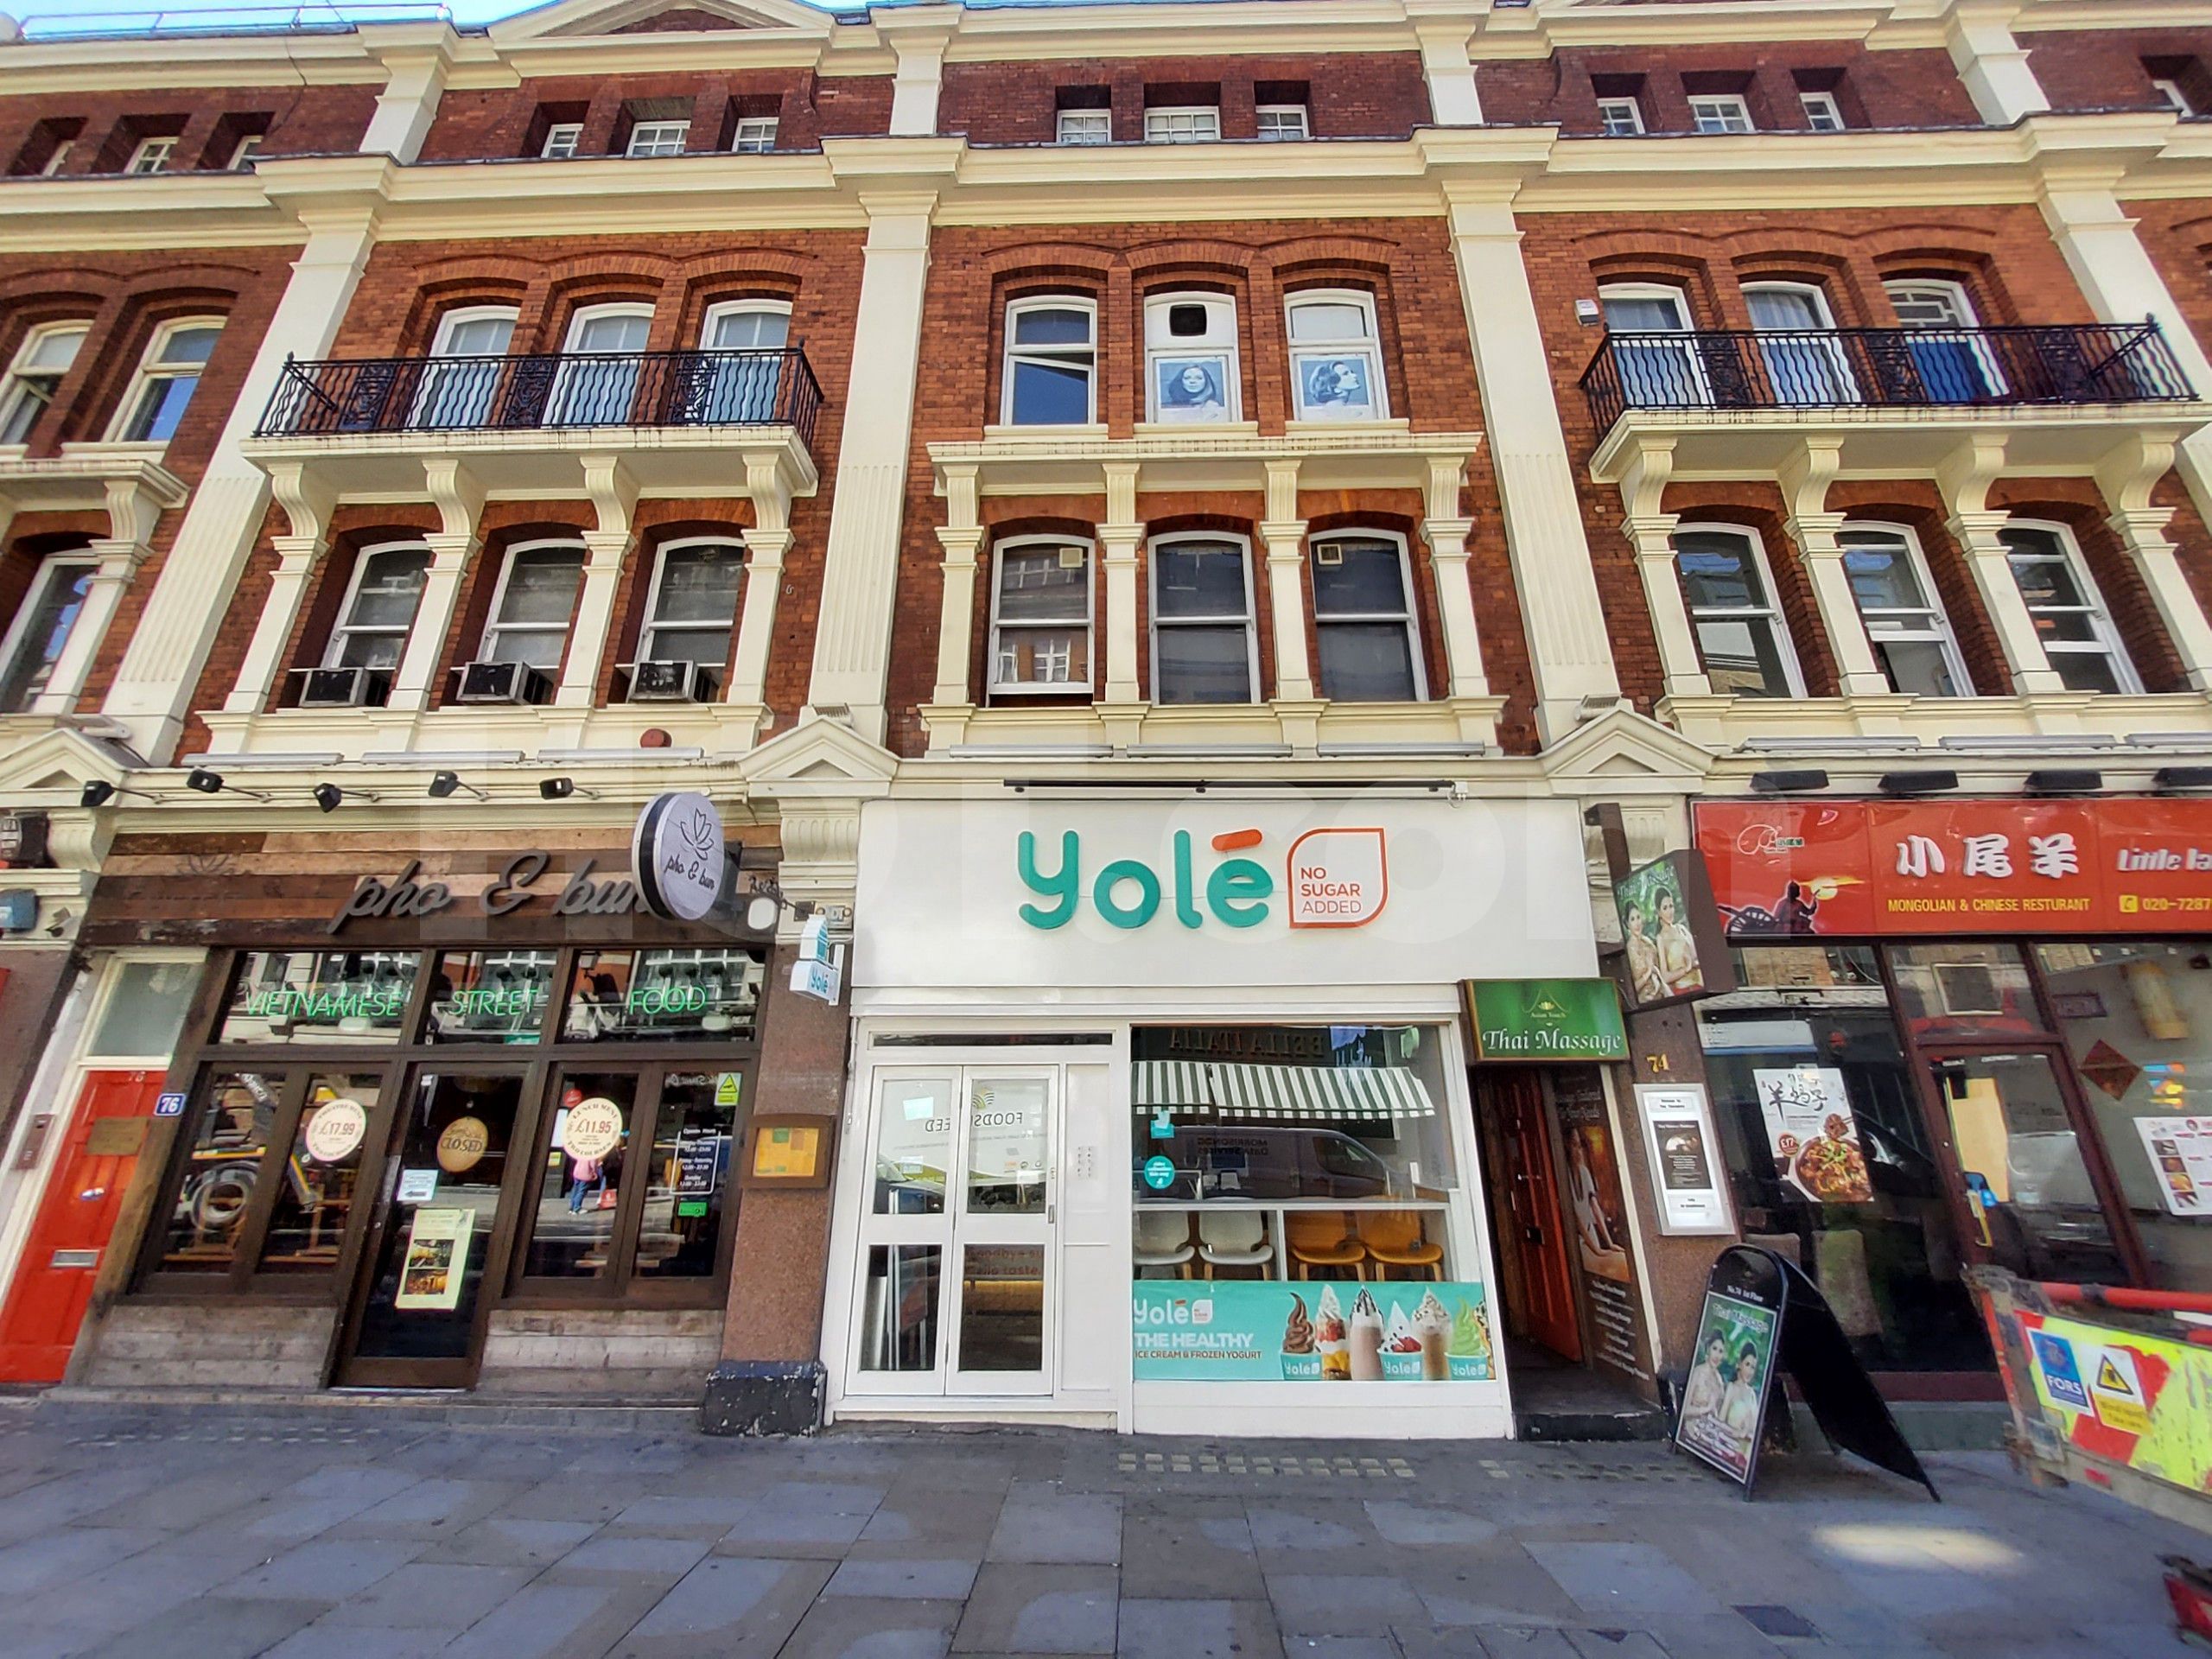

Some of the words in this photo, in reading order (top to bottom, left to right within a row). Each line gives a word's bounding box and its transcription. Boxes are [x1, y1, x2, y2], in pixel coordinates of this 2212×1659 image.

[664, 853, 684, 874] pho
[2116, 848, 2182, 872] Little
[1300, 867, 1327, 880] NO
[327, 859, 453, 935] pho
[478, 849, 553, 916] &
[553, 857, 650, 915] bu
[1300, 882, 1361, 898] SUGAR
[1301, 900, 1362, 914] ADDED
[1887, 899, 1956, 912] MONGOLIAN
[1959, 899, 1969, 912] &
[1972, 898, 2019, 912] CHINESE
[2022, 898, 2091, 912] RESTURANT
[245, 988, 404, 1018] VIETNAMESE
[451, 988, 538, 1016] STREET
[628, 986, 707, 1015] FOOD
[1481, 1028, 1530, 1050] Thai
[1535, 1027, 1622, 1056] Massage
[1646, 1053, 1670, 1073] 74
[160, 1096, 179, 1113] 76
[575, 1118, 613, 1134] £11.95
[441, 1137, 483, 1153] CLOSED
[1134, 1332, 1169, 1348] THE
[1172, 1332, 1255, 1348] HEALTHY
[1134, 1350, 1149, 1359] ICE
[1150, 1350, 1181, 1359] CREAM
[1191, 1350, 1225, 1359] FROZEN
[1226, 1350, 1262, 1359] YOGURT
[2046, 1375, 2082, 1395] FORS
